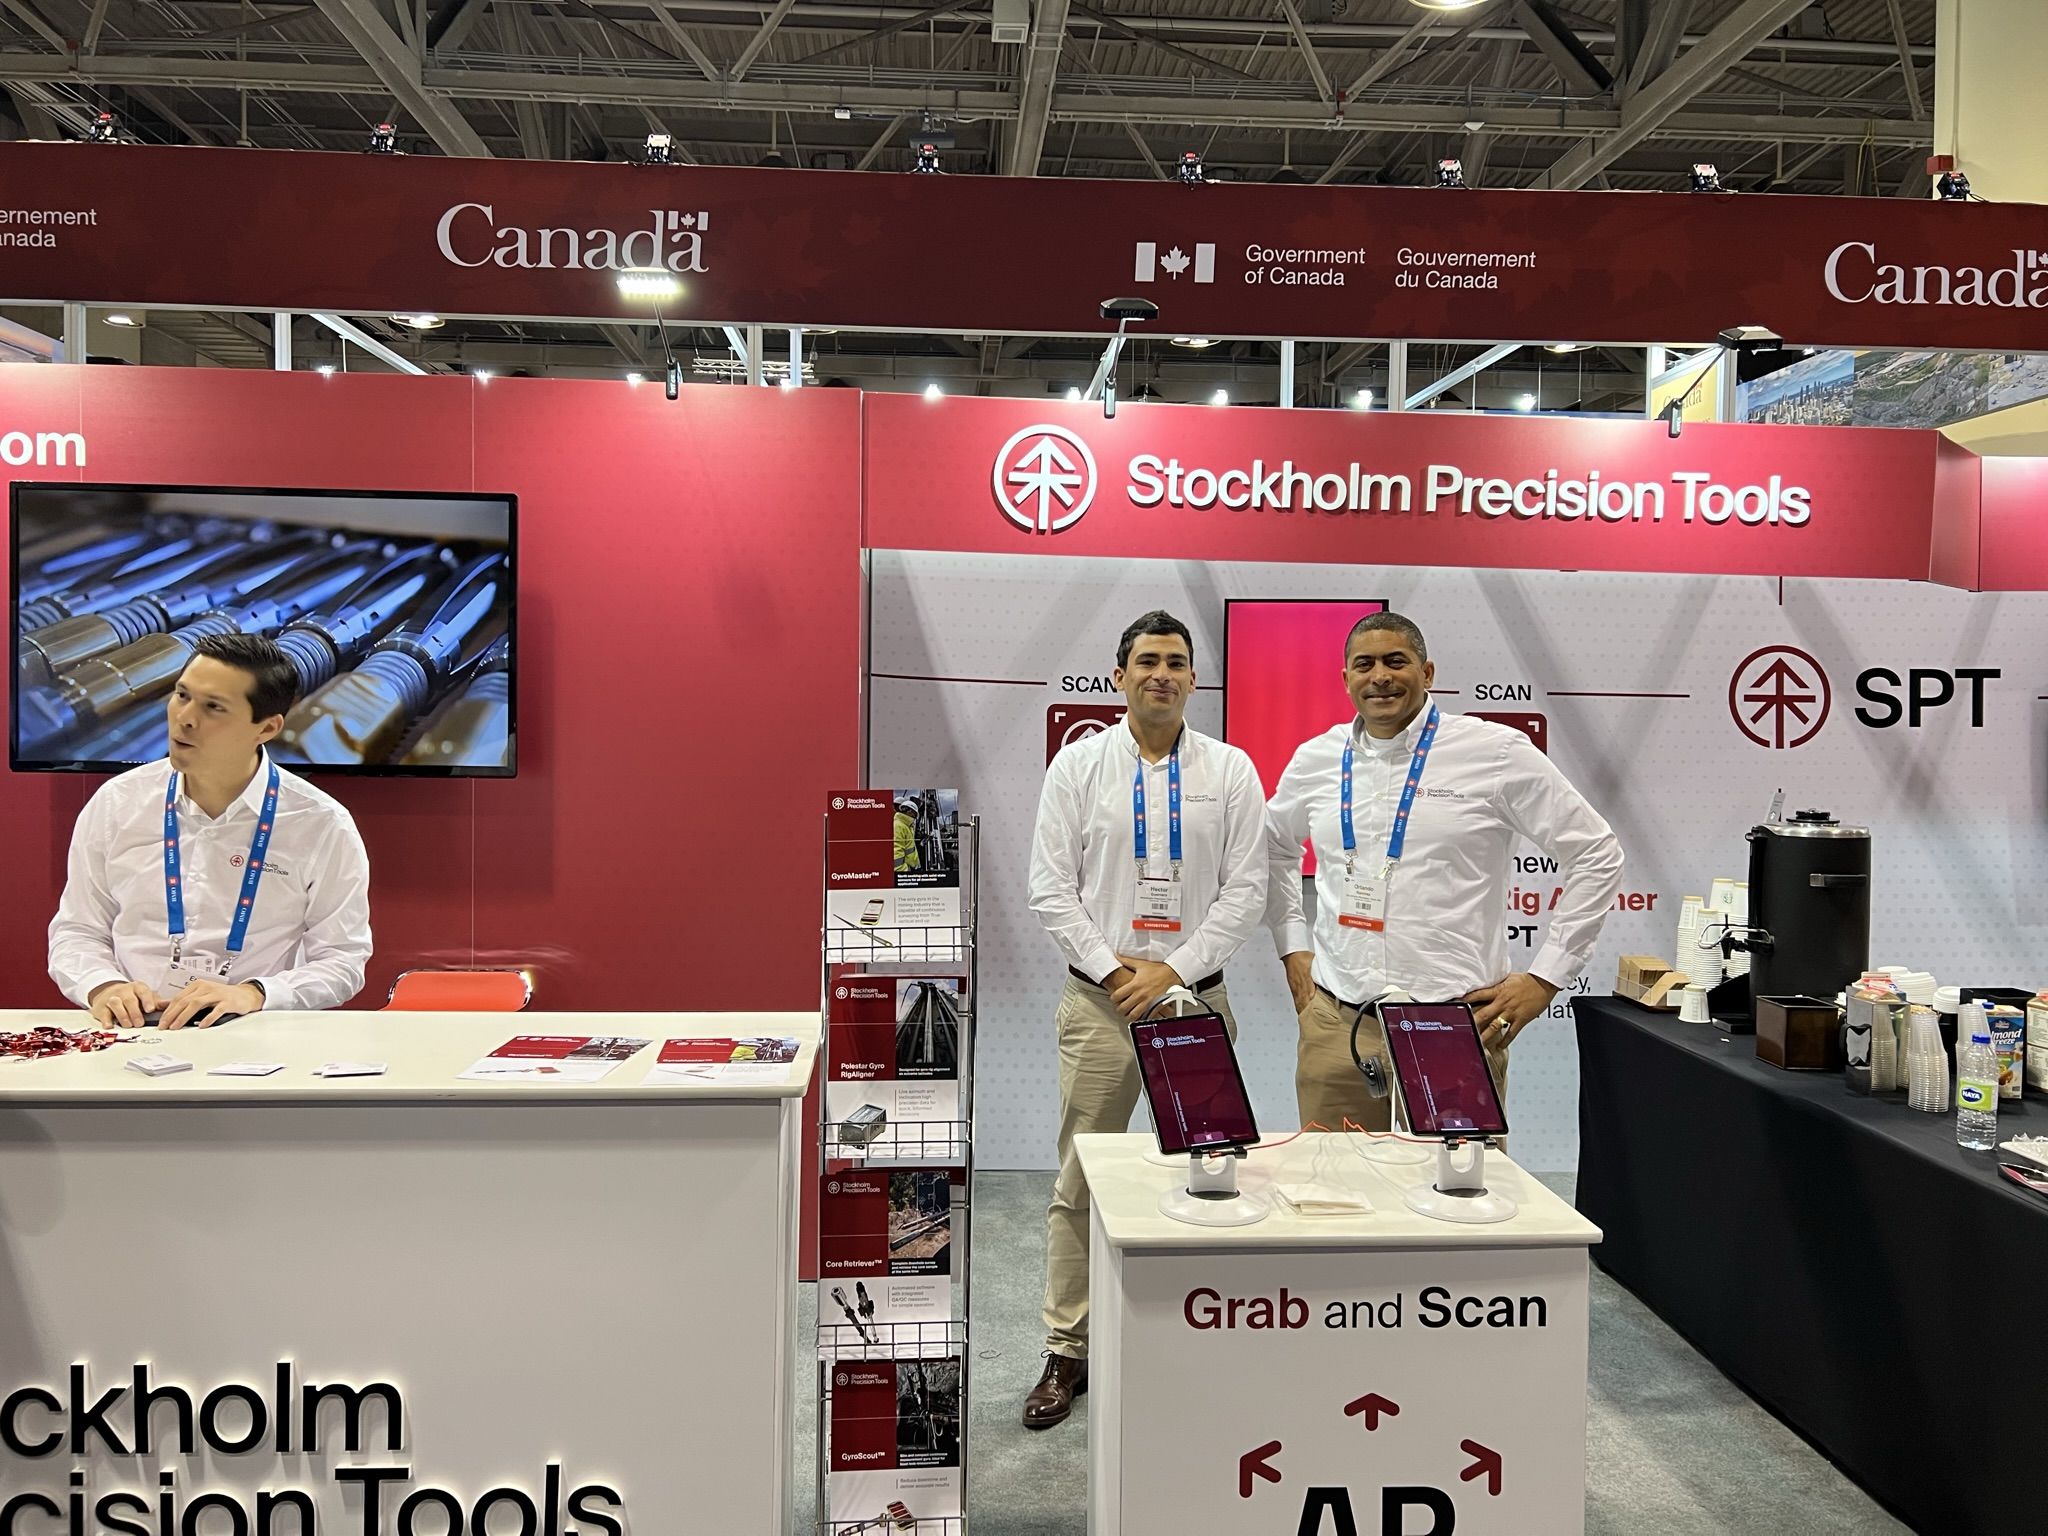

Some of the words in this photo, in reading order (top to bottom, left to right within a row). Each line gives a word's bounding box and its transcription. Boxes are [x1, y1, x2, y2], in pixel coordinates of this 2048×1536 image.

[436, 203, 709, 273] Canada
[1245, 244, 1366, 264] Government
[1396, 247, 1537, 268] Gouvernement
[1244, 267, 1264, 284] of
[1269, 267, 1345, 286] Canada
[1395, 270, 1419, 288] du
[1425, 270, 1498, 289] Canada
[0, 431, 87, 468] om
[1127, 454, 1412, 512] Stockholm
[1425, 464, 1665, 519] Precision
[1672, 472, 1812, 525] Tools
[1061, 675, 1118, 693] SCAN
[1475, 684, 1532, 701] SCAN
[1854, 667, 2001, 729] SPT
[1992, 1029, 2022, 1038] lmond
[841, 1071, 875, 1079] RigAligner
[869, 1063, 885, 1071] Gyro
[825, 1260, 843, 1268] Core
[1183, 1287, 1310, 1329] Grab
[1324, 1293, 1402, 1329] and
[1418, 1286, 1547, 1328] Scan
[0, 1362, 404, 1456] ckholm
[335, 1463, 624, 1536] Tools
